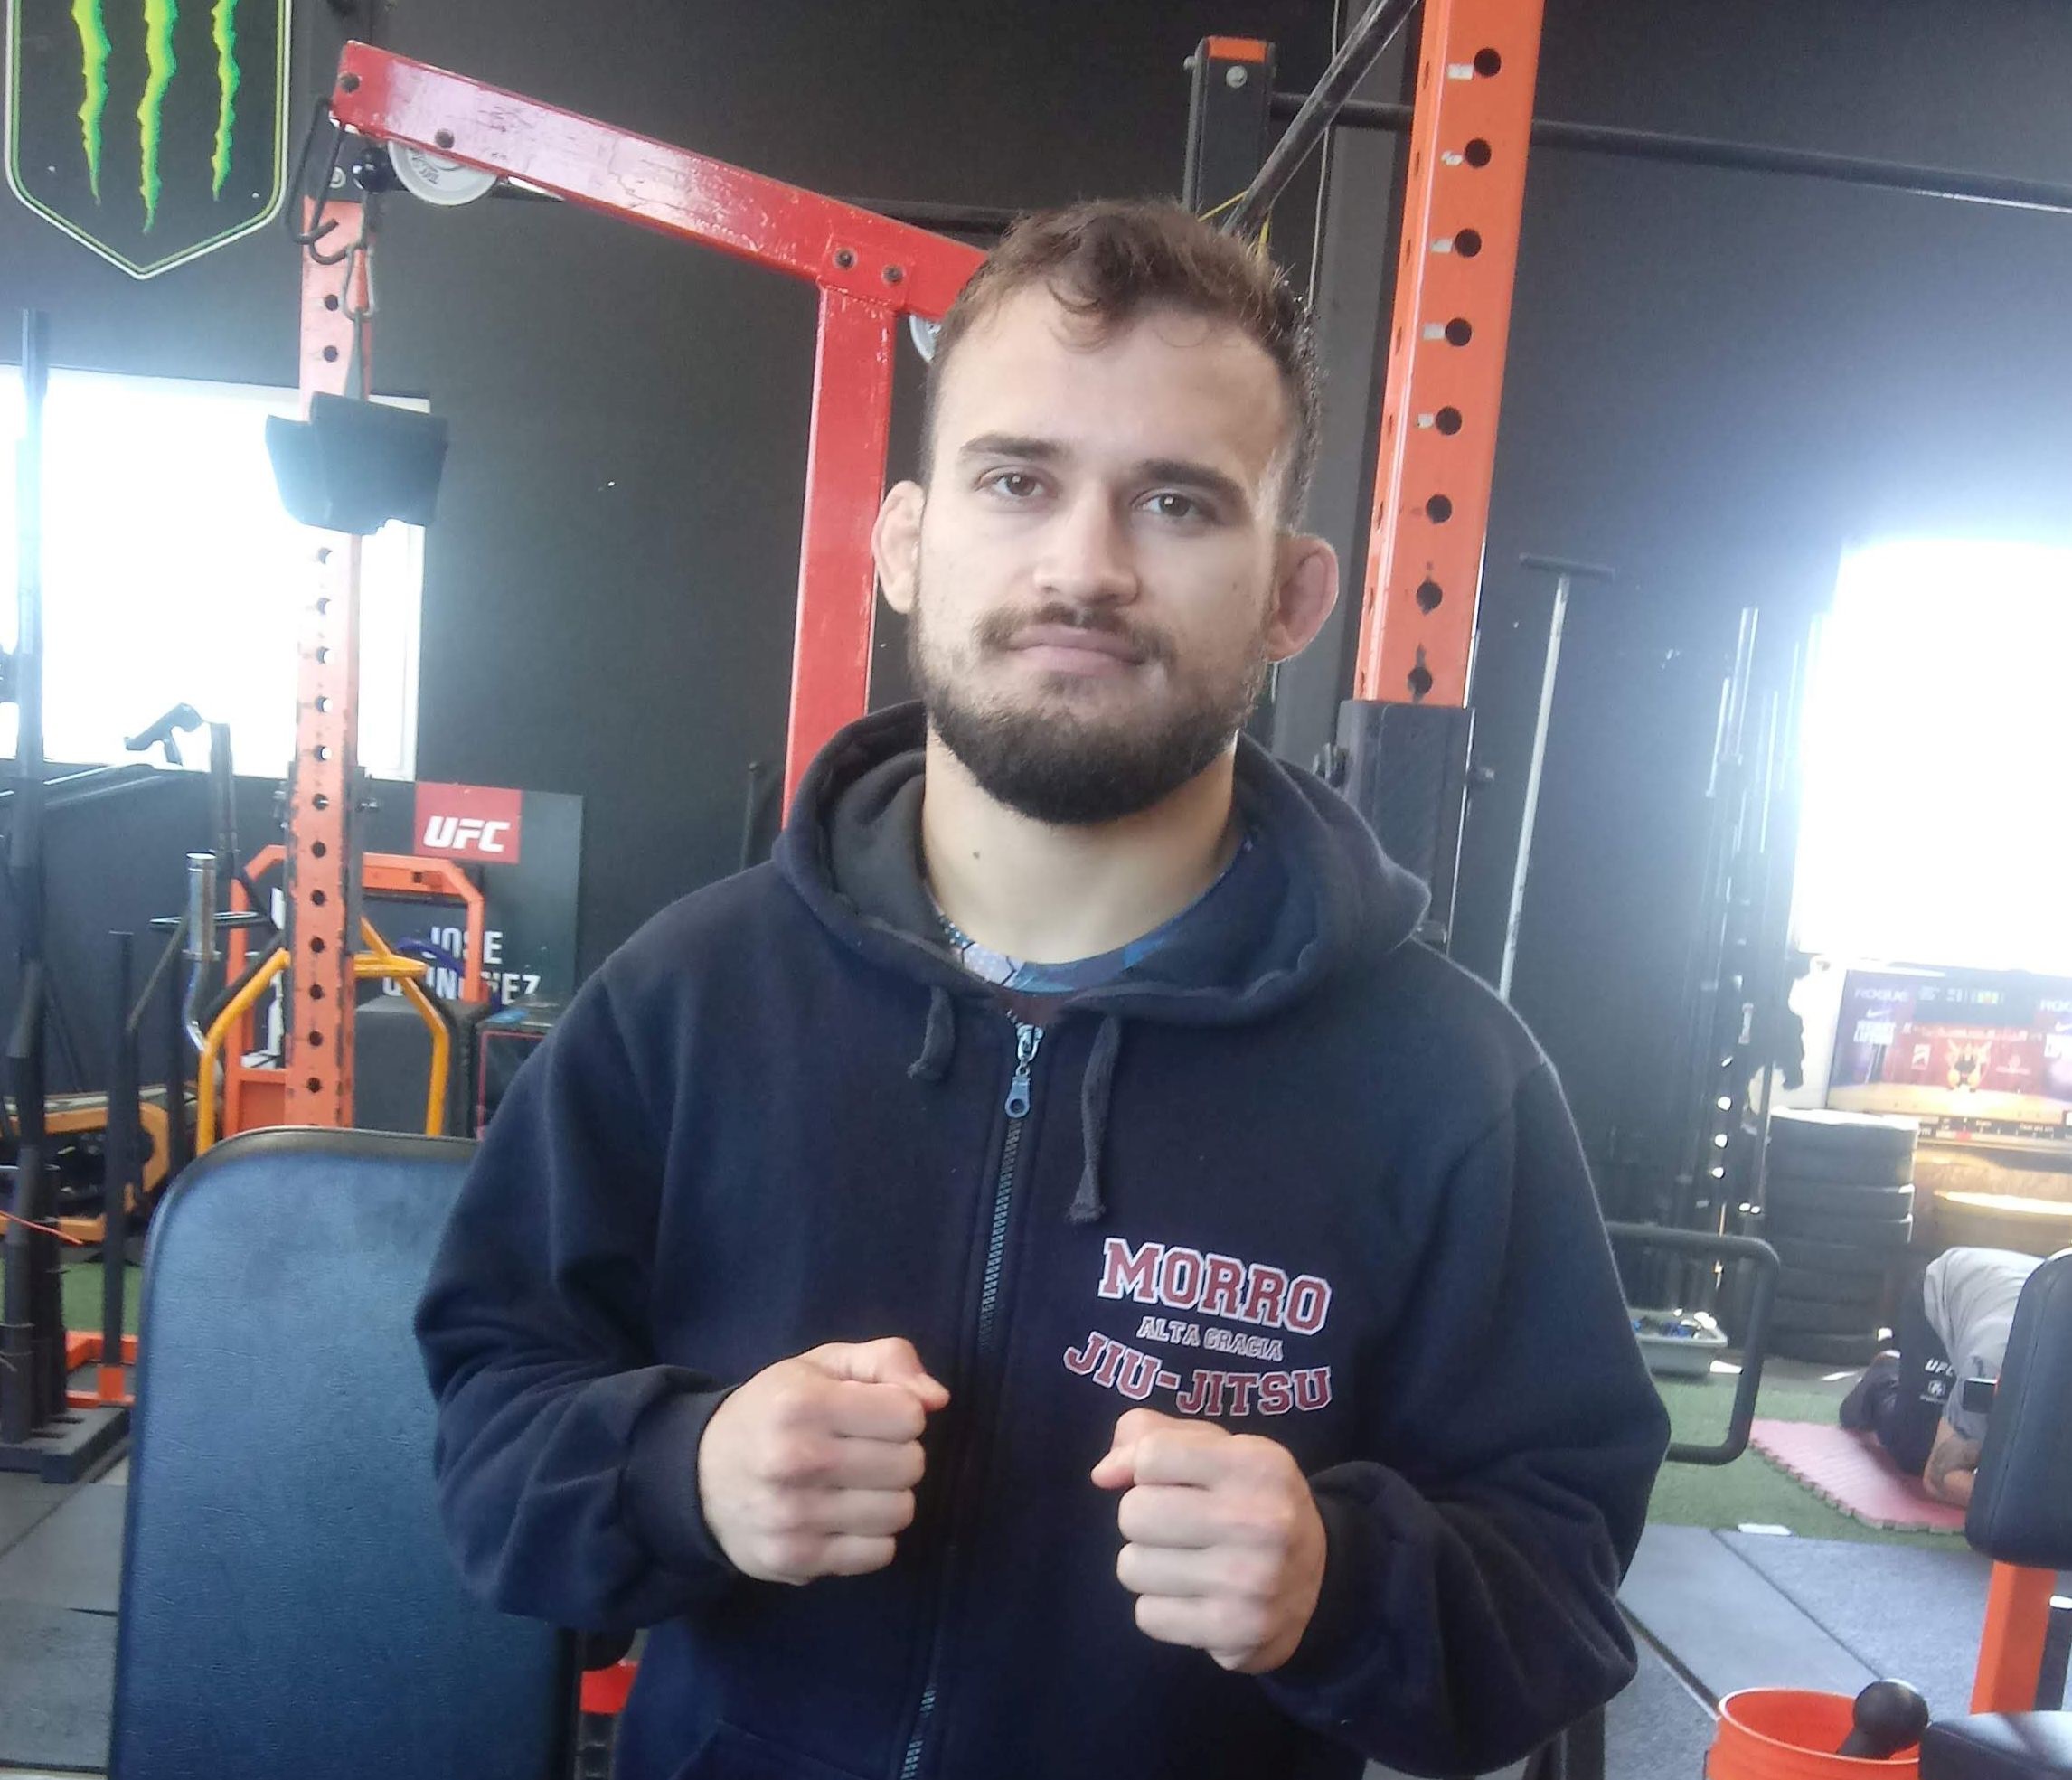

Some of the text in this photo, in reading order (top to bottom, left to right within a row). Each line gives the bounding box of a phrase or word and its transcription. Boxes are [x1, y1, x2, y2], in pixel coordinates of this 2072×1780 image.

[423, 815, 511, 852] UFC
[421, 926, 504, 964] JOE
[1097, 1237, 1332, 1336] MORRO
[1136, 1316, 1285, 1362] ALTA GRACIA
[1063, 1331, 1332, 1417] JIU-JITSU
